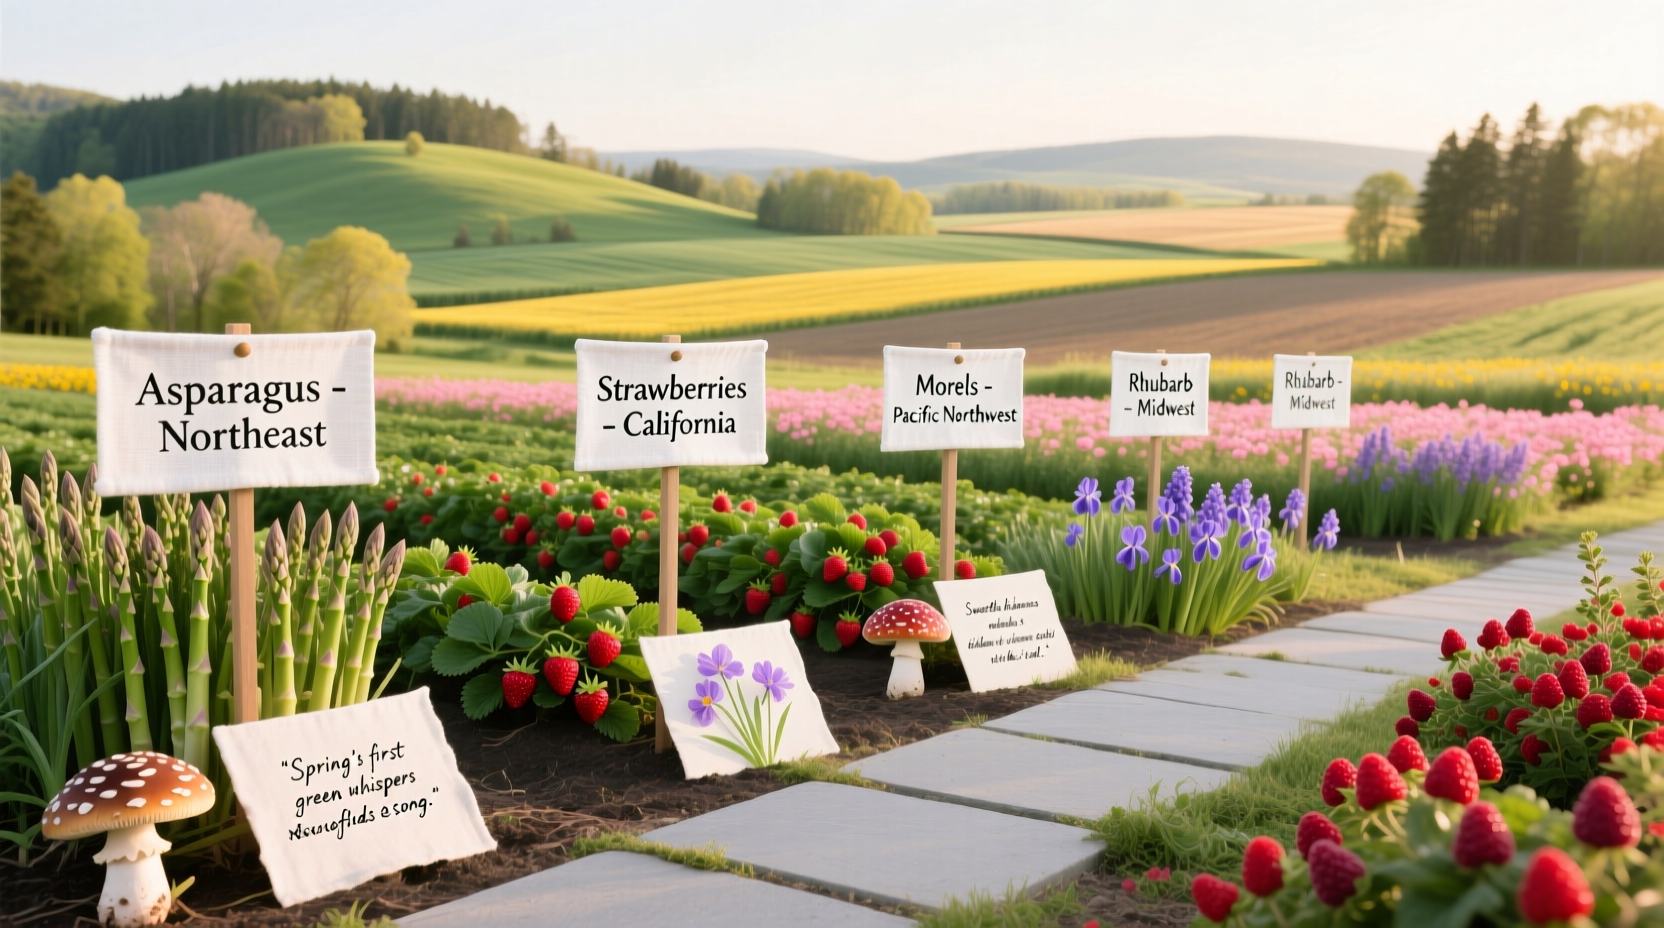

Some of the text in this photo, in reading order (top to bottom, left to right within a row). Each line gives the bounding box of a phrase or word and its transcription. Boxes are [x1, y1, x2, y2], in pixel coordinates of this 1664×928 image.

[135, 371, 320, 416] Asparagus
[597, 373, 748, 402] Strawberries
[915, 372, 979, 396] Morels
[1129, 370, 1194, 393] Rhubarb
[893, 403, 1018, 424] Pacific Northwest
[1137, 397, 1195, 417] Midwest
[1290, 394, 1336, 411] Midwest
[158, 409, 328, 453] Northeast
[623, 409, 737, 441] California
[368, 741, 405, 774] first
[295, 770, 416, 817] green whispers
